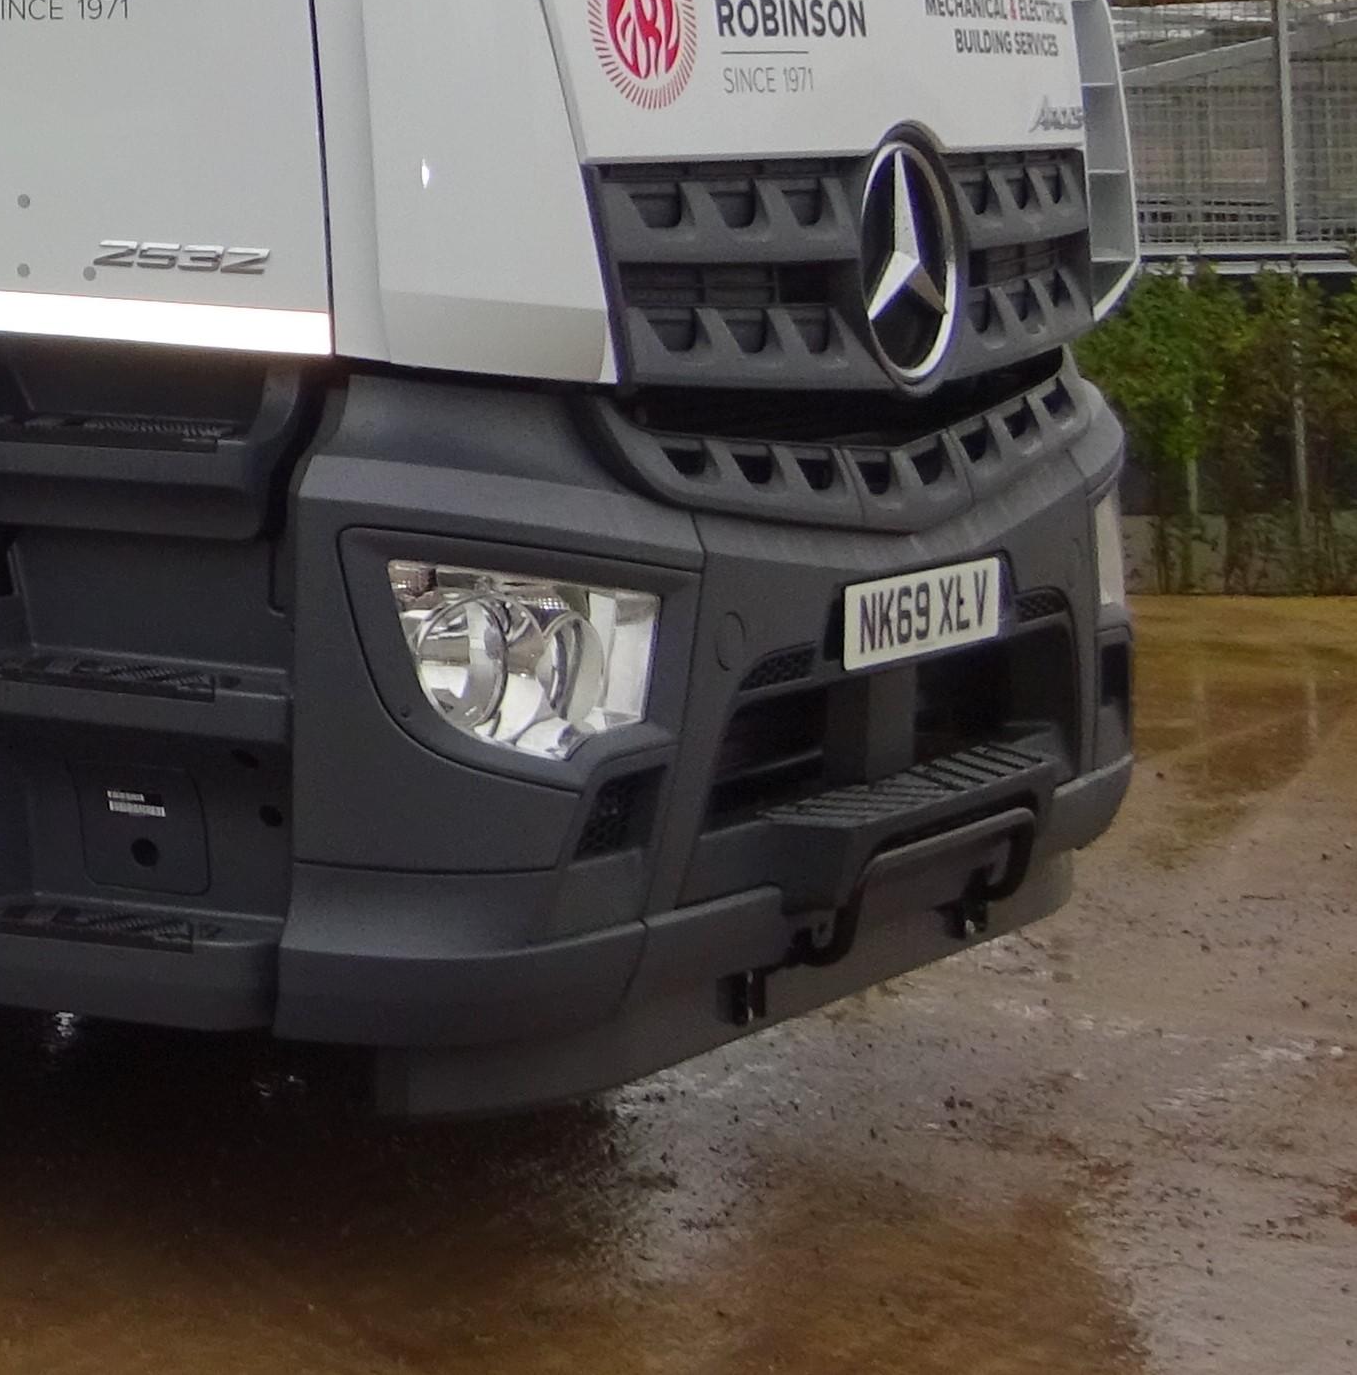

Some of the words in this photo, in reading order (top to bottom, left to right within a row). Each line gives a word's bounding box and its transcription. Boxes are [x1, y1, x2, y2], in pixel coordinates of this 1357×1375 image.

[954, 28, 1013, 54] BUILDING
[1014, 31, 1059, 57] SERVICES
[723, 66, 777, 94] SINCE
[782, 65, 814, 93] 1971
[93, 239, 271, 275] 2532
[859, 581, 931, 655] NK69
[938, 569, 989, 637] XLV
